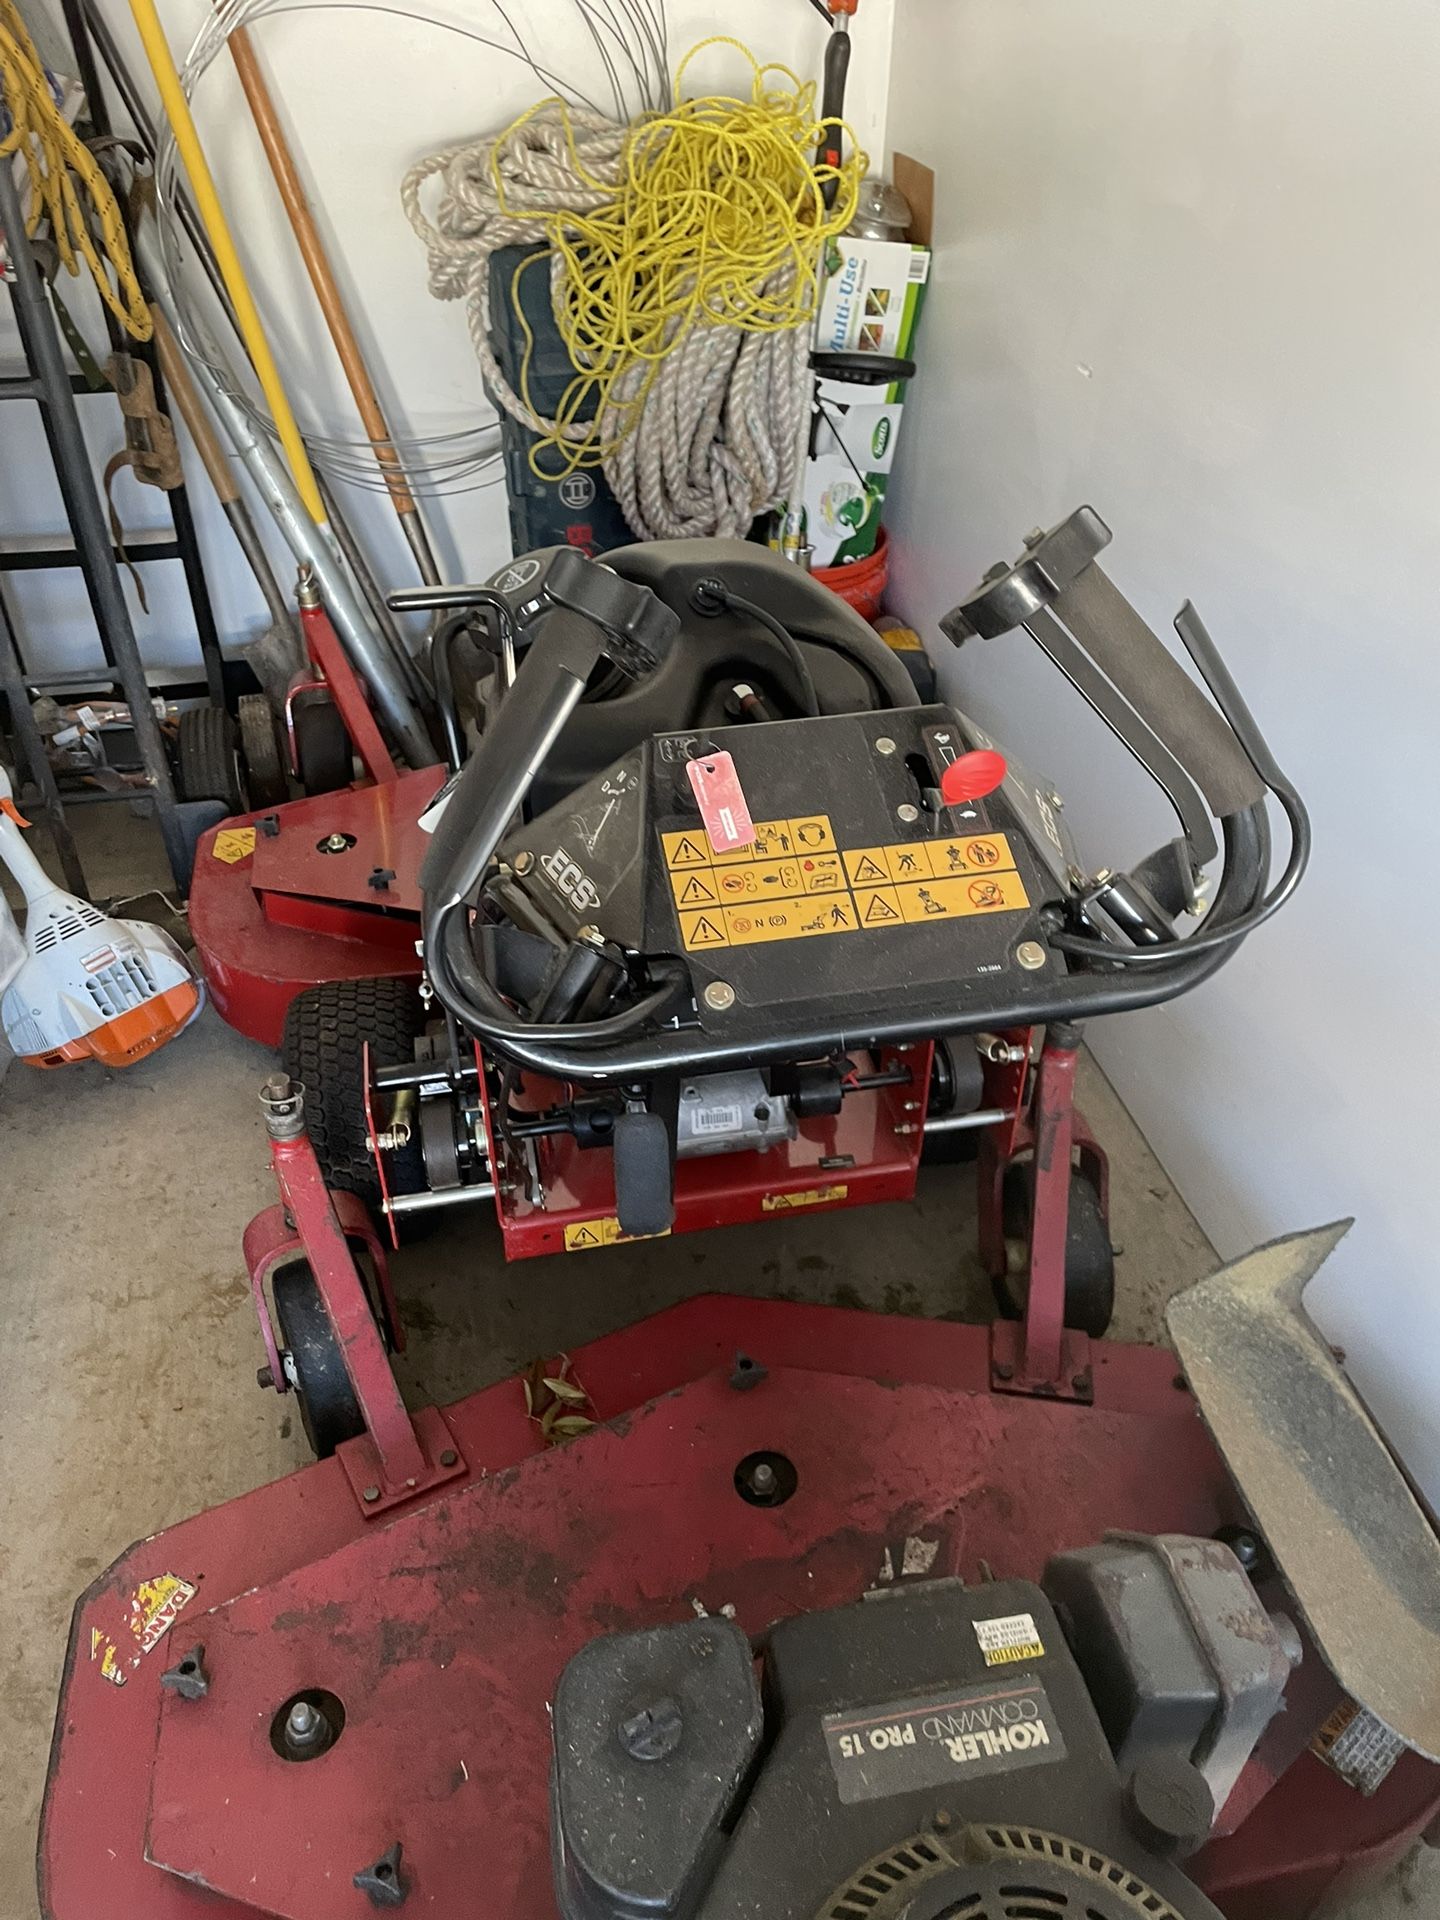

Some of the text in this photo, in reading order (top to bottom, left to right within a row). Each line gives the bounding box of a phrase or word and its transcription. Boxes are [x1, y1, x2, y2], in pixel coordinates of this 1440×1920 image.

[601, 780, 611, 793] D
[545, 848, 597, 911] ECS
[755, 919, 764, 928] N
[922, 1698, 1039, 1740] COMMAND
[839, 1732, 866, 1758] 15
